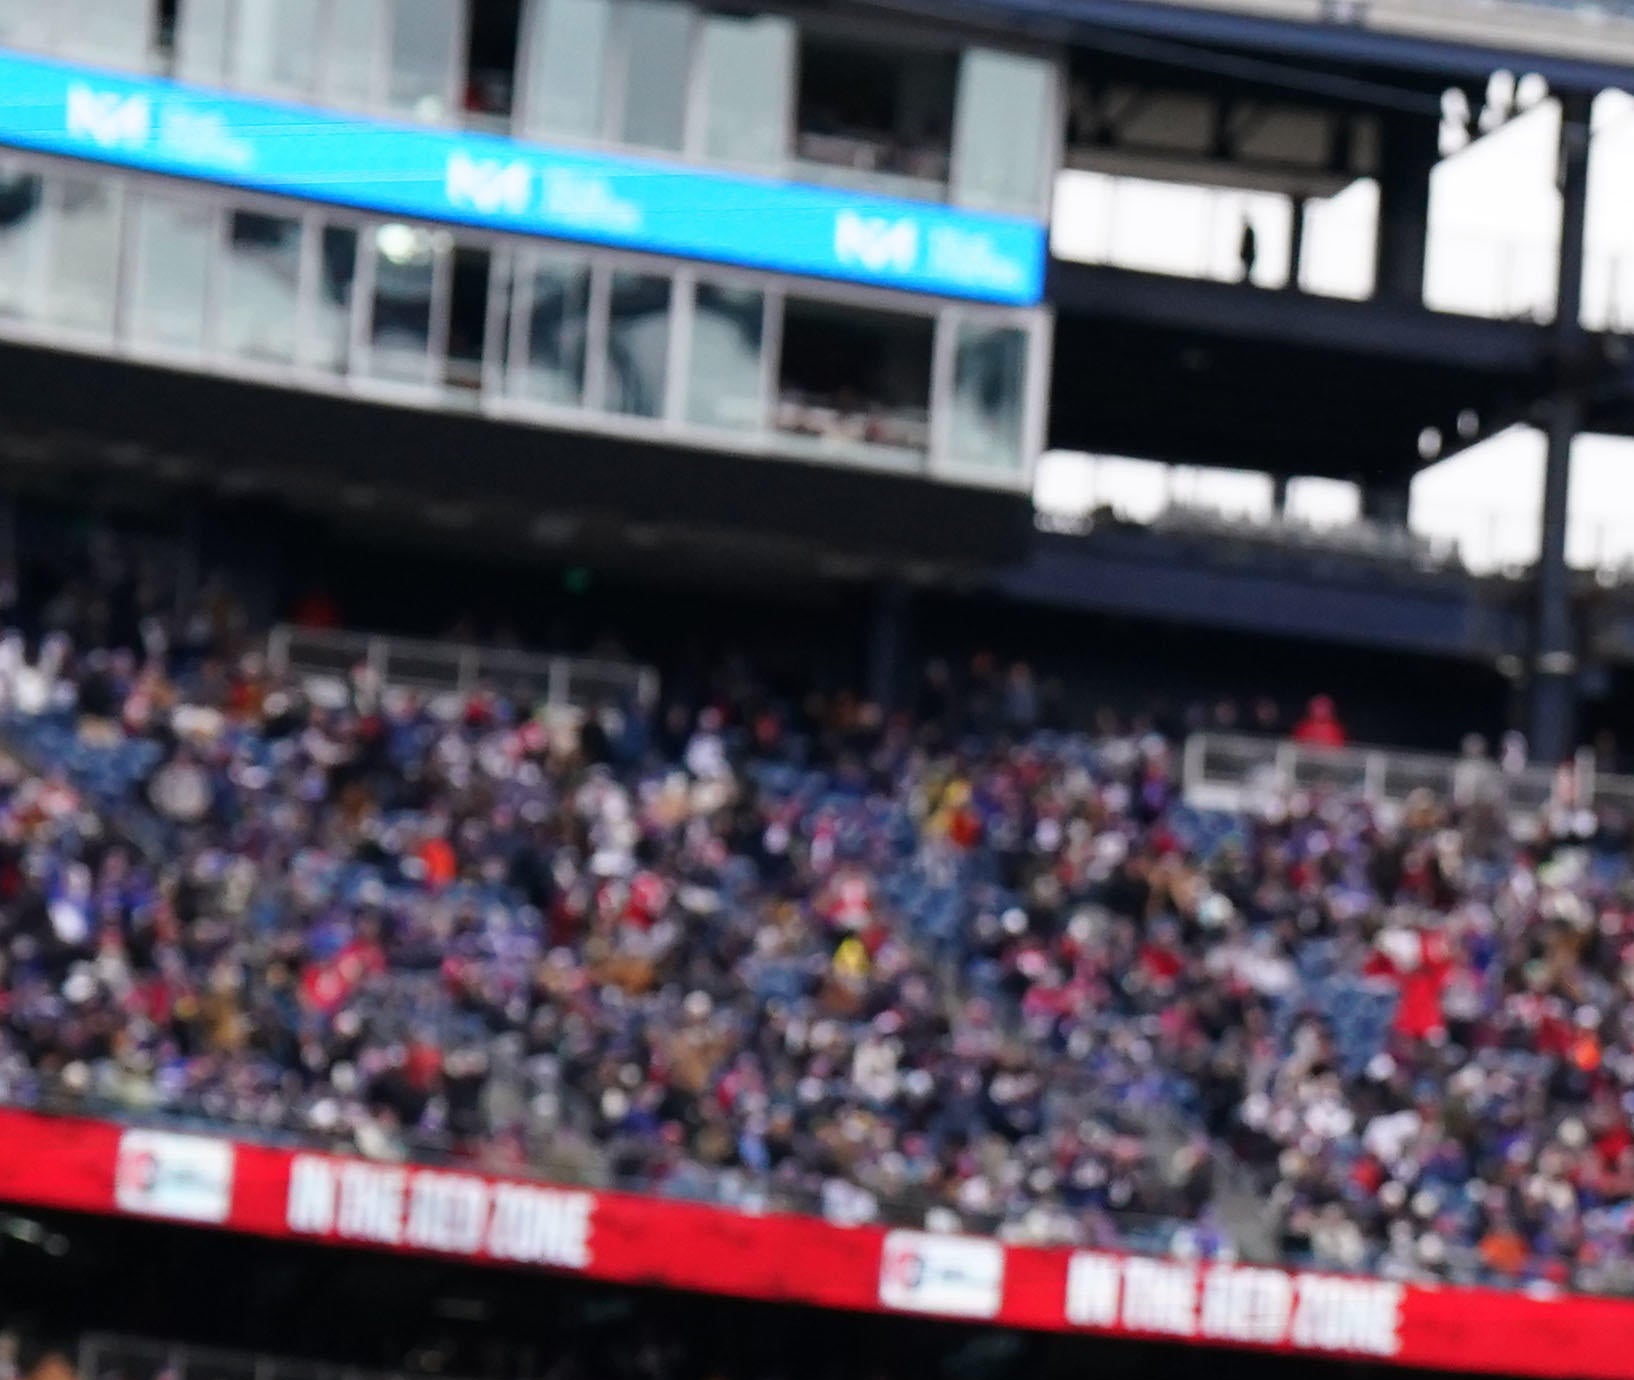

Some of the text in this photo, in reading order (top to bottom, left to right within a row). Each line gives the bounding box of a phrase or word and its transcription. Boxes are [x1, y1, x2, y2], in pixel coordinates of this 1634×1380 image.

[286, 1154, 599, 1268] IN THE RED ZONE
[1065, 1250, 1403, 1356] IN THE RED ZONE
